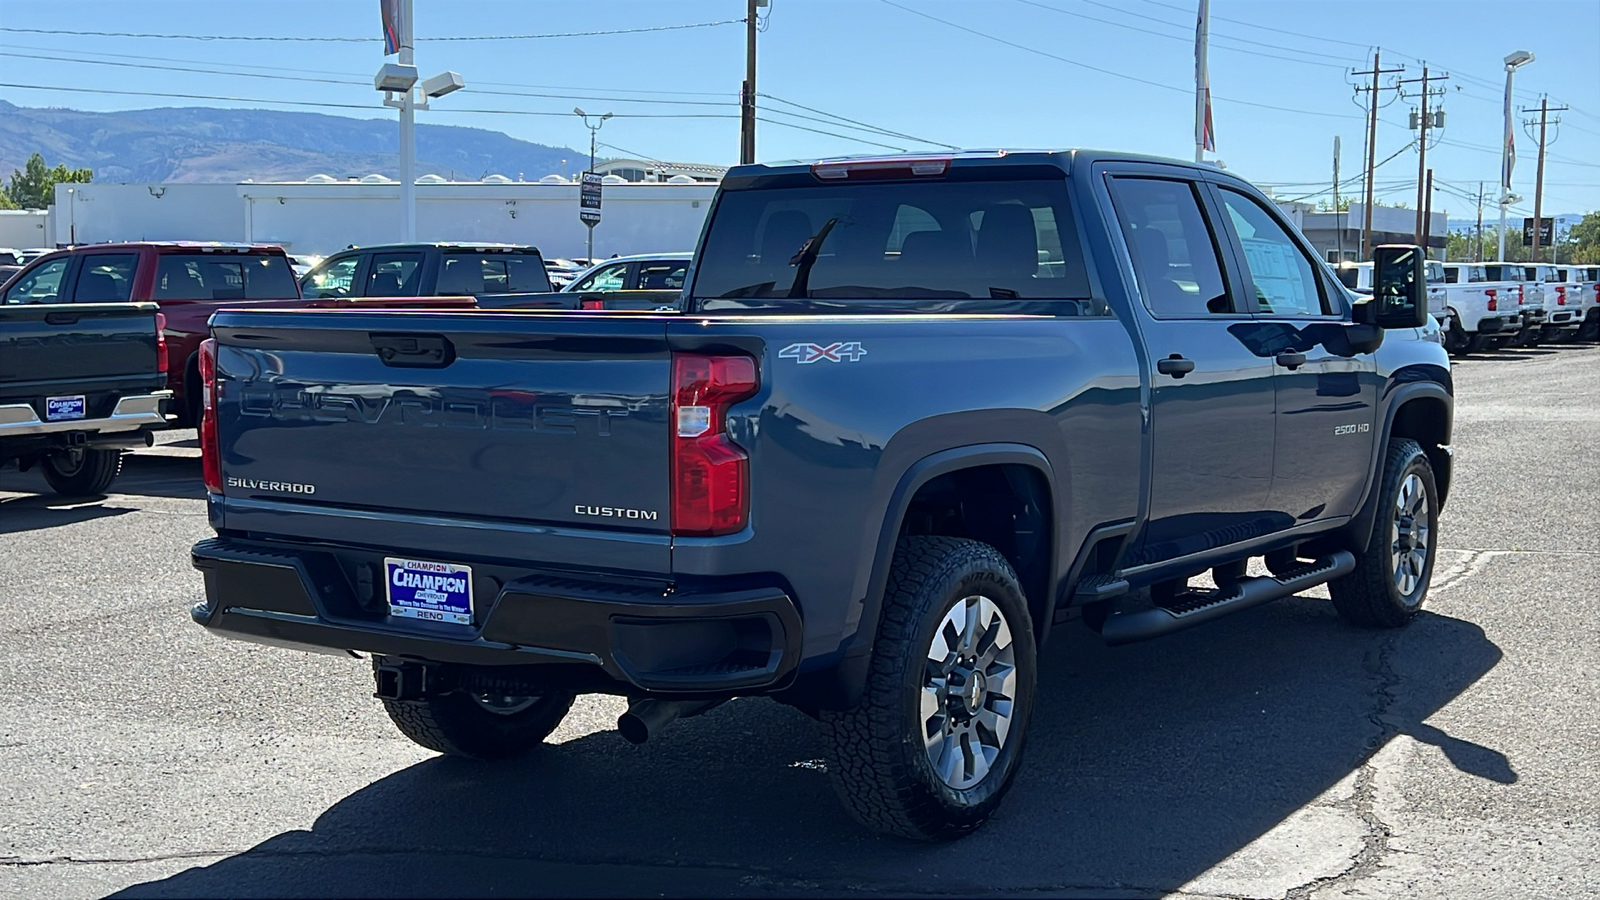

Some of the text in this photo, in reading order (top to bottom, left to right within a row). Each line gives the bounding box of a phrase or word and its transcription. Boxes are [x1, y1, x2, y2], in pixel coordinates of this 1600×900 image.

[240, 388, 630, 438] CHEVROLET
[1334, 423, 1369, 435] 2500 HD
[227, 476, 316, 495] SILVERADO
[574, 504, 658, 520] CUSTOM
[407, 561, 447, 572] CHAMPION
[392, 568, 466, 594] CHAMPION
[416, 591, 446, 600] CHEVROLET
[417, 610, 444, 621] RENO
